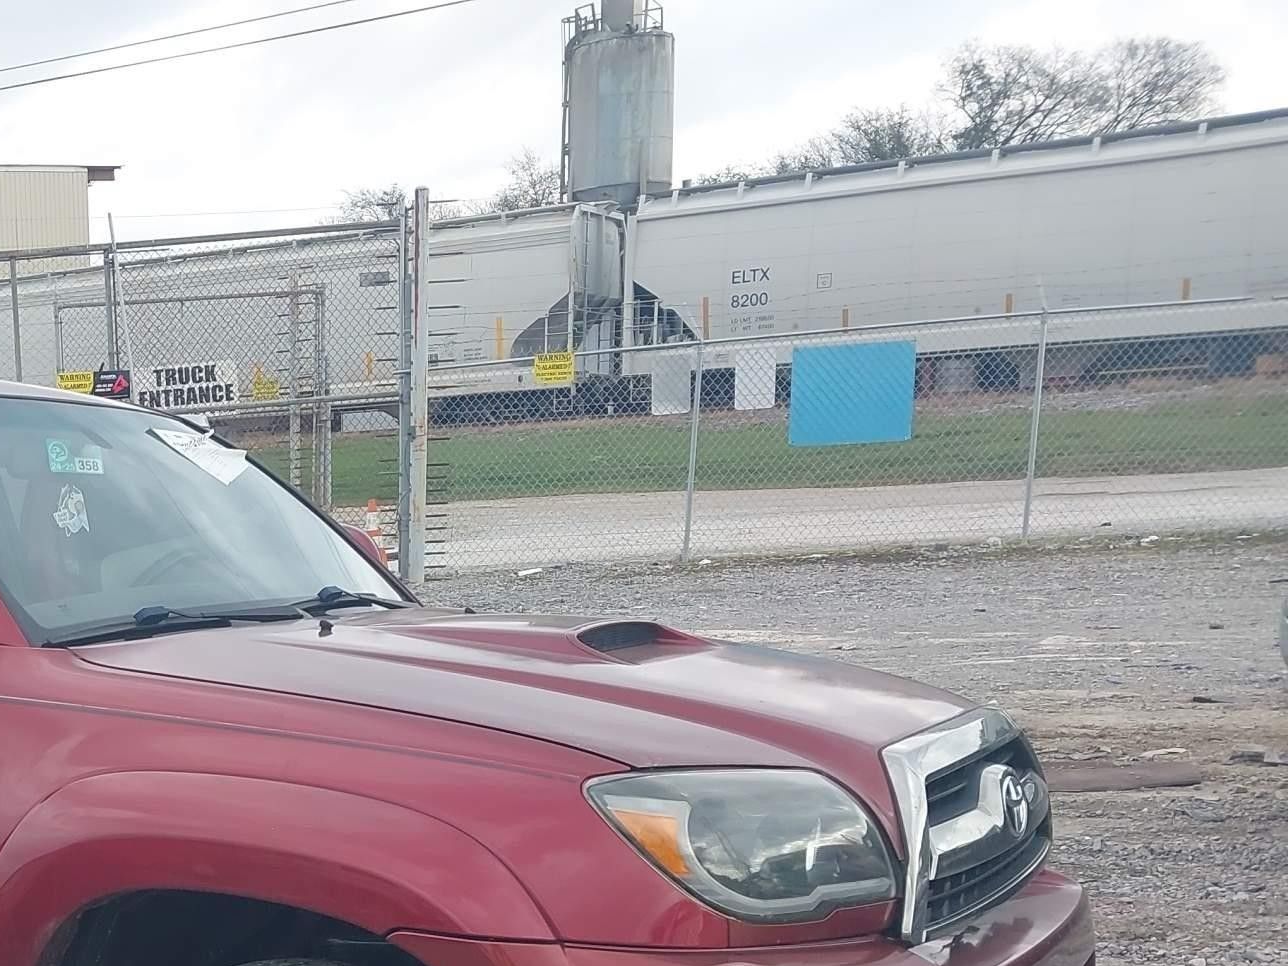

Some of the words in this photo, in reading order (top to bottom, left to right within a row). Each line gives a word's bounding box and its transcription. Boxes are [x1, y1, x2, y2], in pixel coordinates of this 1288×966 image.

[732, 267, 770, 284] ELTX
[731, 292, 768, 308] 8200
[538, 353, 571, 362] WARNING
[59, 373, 91, 382] WARNING
[153, 364, 217, 387] TRUCK
[138, 383, 235, 408] ENTRANCE
[78, 459, 99, 471] 358
